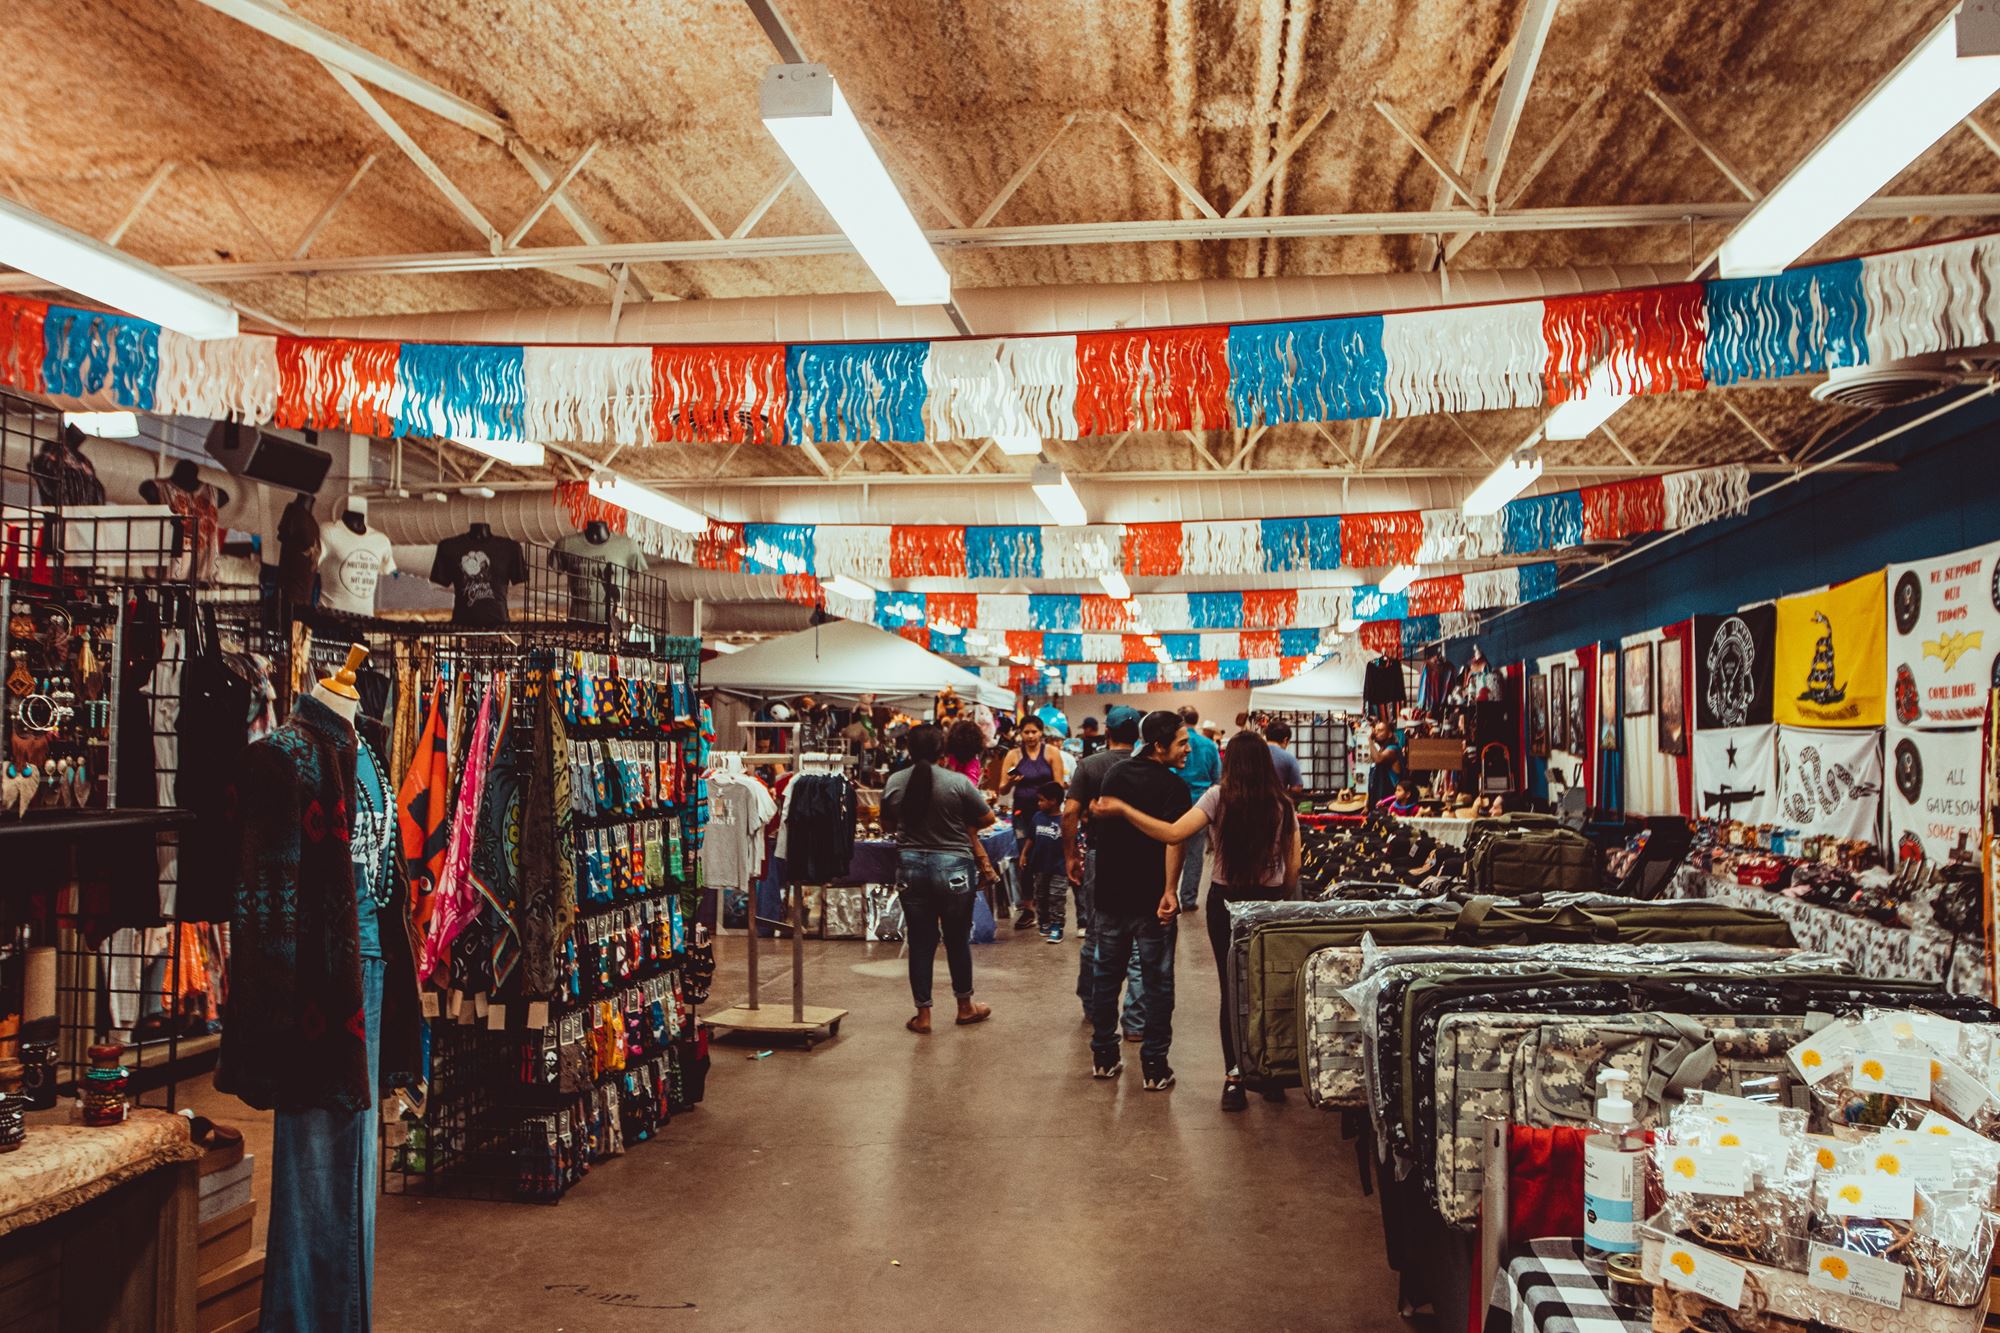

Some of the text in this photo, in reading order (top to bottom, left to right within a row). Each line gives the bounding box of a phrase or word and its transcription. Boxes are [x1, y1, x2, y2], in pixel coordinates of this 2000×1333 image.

[1930, 559, 1982, 584] WE SUPPORT
[1944, 586, 1960, 601] OUR
[1937, 604, 1968, 623] TROOPS
[1928, 683, 1976, 700] COME HOME
[1947, 769, 1966, 785] ALL
[1927, 824, 1955, 841] SOME
[1695, 1280, 1724, 1300] Exotic
[1848, 1280, 1865, 1292] The
